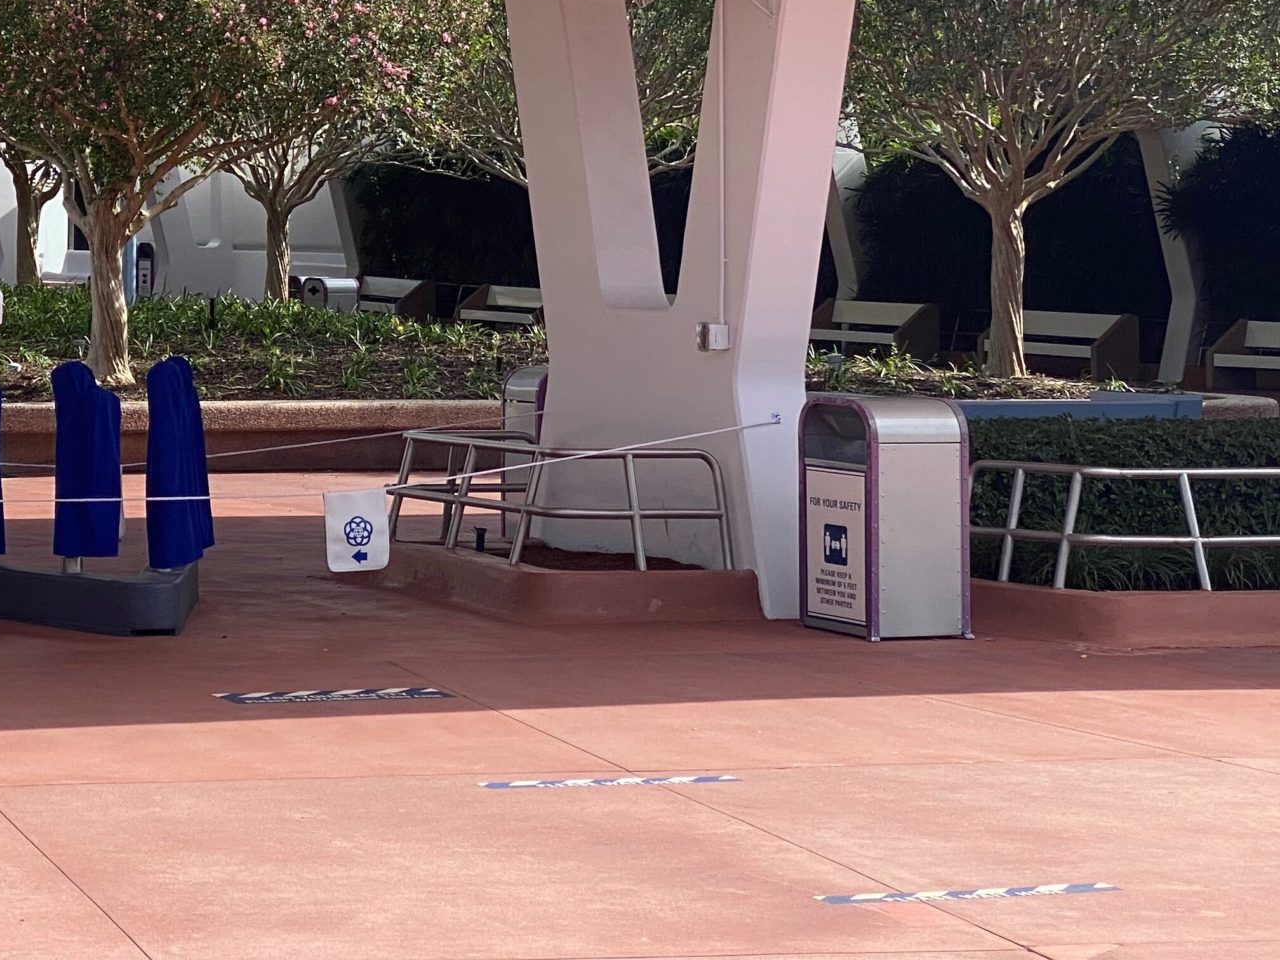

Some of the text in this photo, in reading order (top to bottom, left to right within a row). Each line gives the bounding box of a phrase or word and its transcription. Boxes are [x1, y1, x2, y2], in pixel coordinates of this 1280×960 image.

[810, 497, 861, 511] FOR YOUR SAFETY
[820, 569, 835, 577] PLEASE
[837, 571, 847, 579] KEEP
[816, 578, 835, 587] MINIMUM
[816, 587, 836, 596] BETWEEN
[820, 597, 852, 609] OTHER PARTIES
